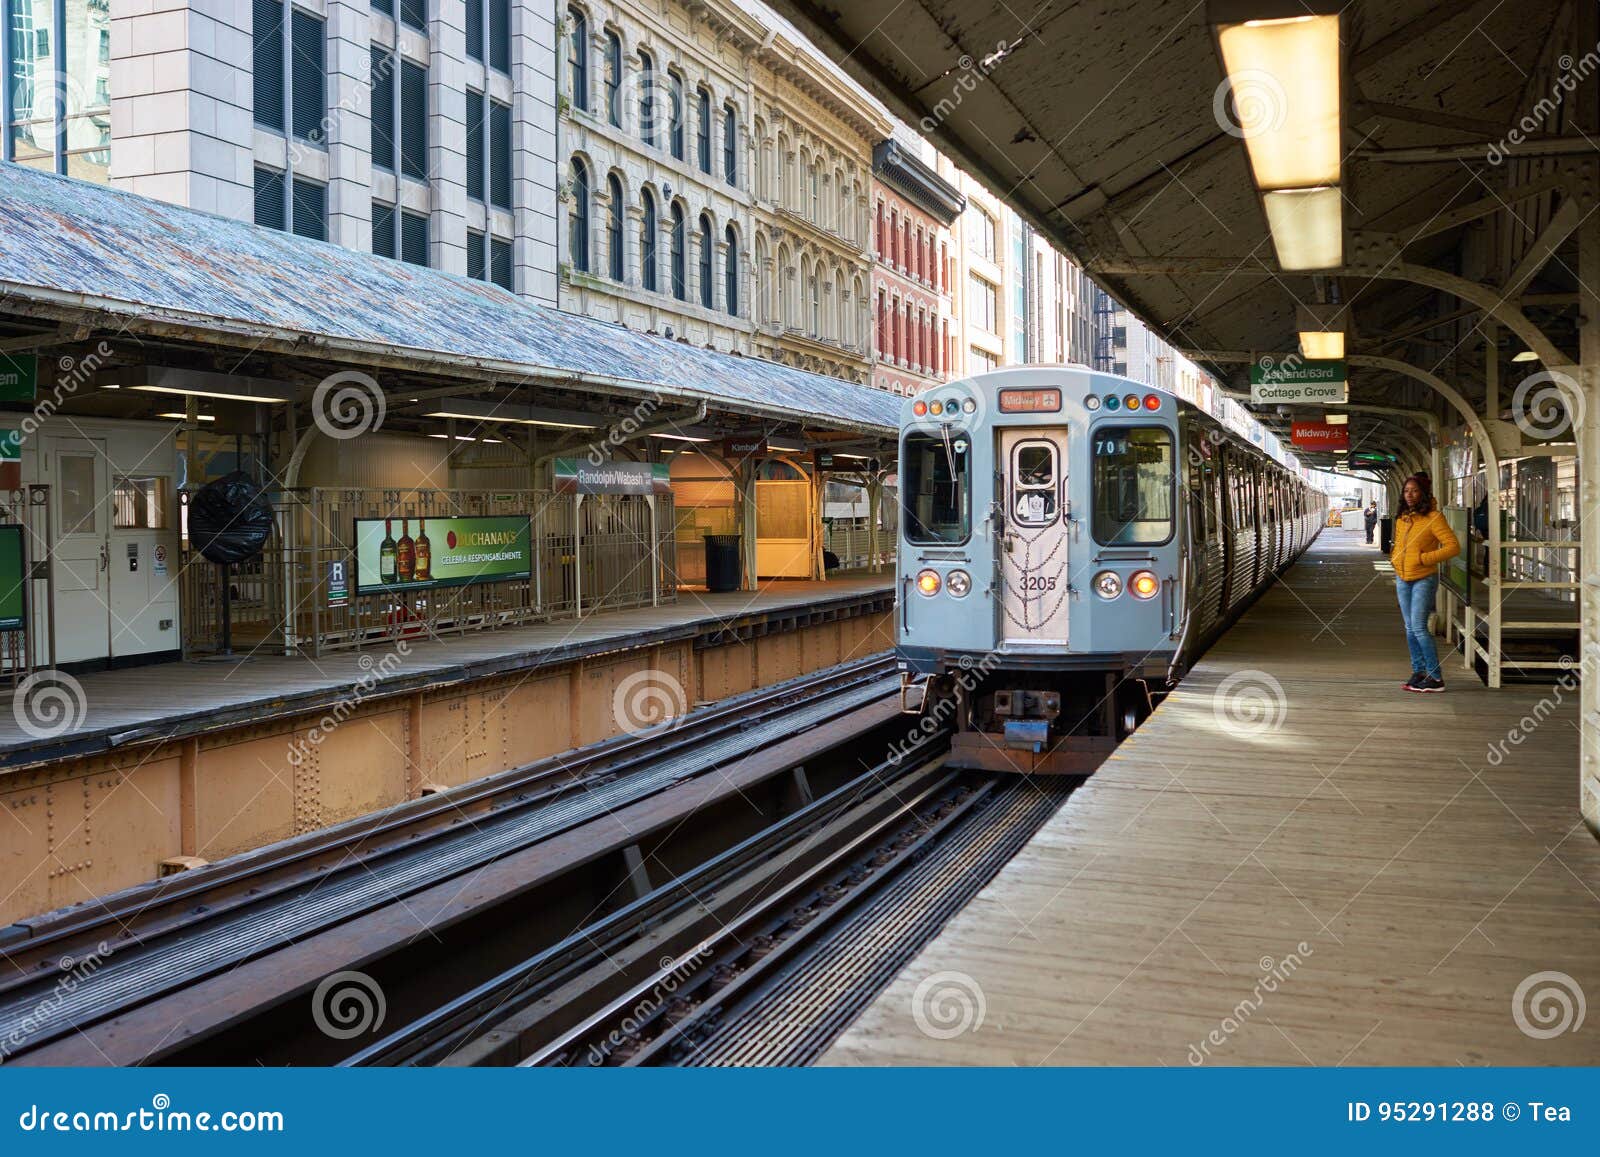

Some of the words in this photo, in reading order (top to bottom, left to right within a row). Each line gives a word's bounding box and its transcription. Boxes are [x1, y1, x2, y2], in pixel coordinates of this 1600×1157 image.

[1262, 367, 1333, 379] Ashland/63rd
[1258, 388, 1301, 399] Cottage
[1304, 386, 1337, 397] Grove
[1296, 428, 1330, 439] Midway
[731, 443, 759, 452] Kimball
[579, 469, 643, 488] Randolph/Wabash
[333, 562, 343, 580] R
[1020, 577, 1056, 591] 3205
